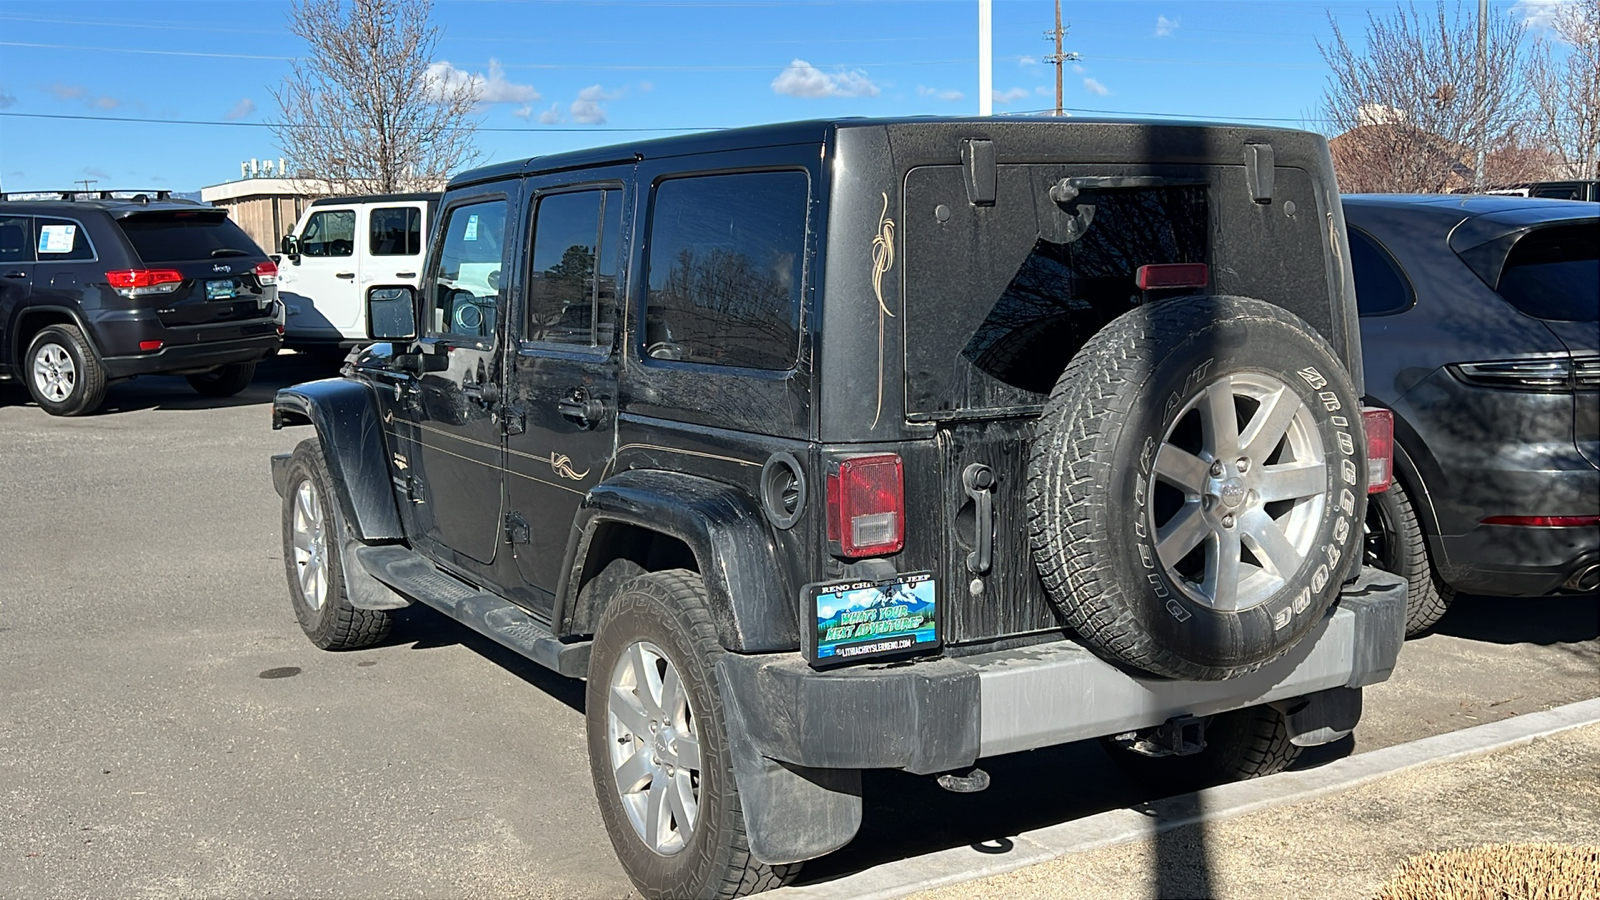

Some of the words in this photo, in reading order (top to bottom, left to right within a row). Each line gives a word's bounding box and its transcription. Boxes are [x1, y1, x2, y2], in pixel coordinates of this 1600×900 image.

[213, 264, 231, 273] Jeep
[1161, 358, 1214, 426] A/T
[1275, 366, 1358, 631] BRIDGESTONE
[1134, 436, 1193, 623] DUELER
[822, 584, 850, 594] RENO
[906, 574, 931, 583] JEEP
[879, 605, 908, 620] YOUR
[825, 626, 855, 641] NEXT
[855, 616, 924, 638] ADVENTURE?
